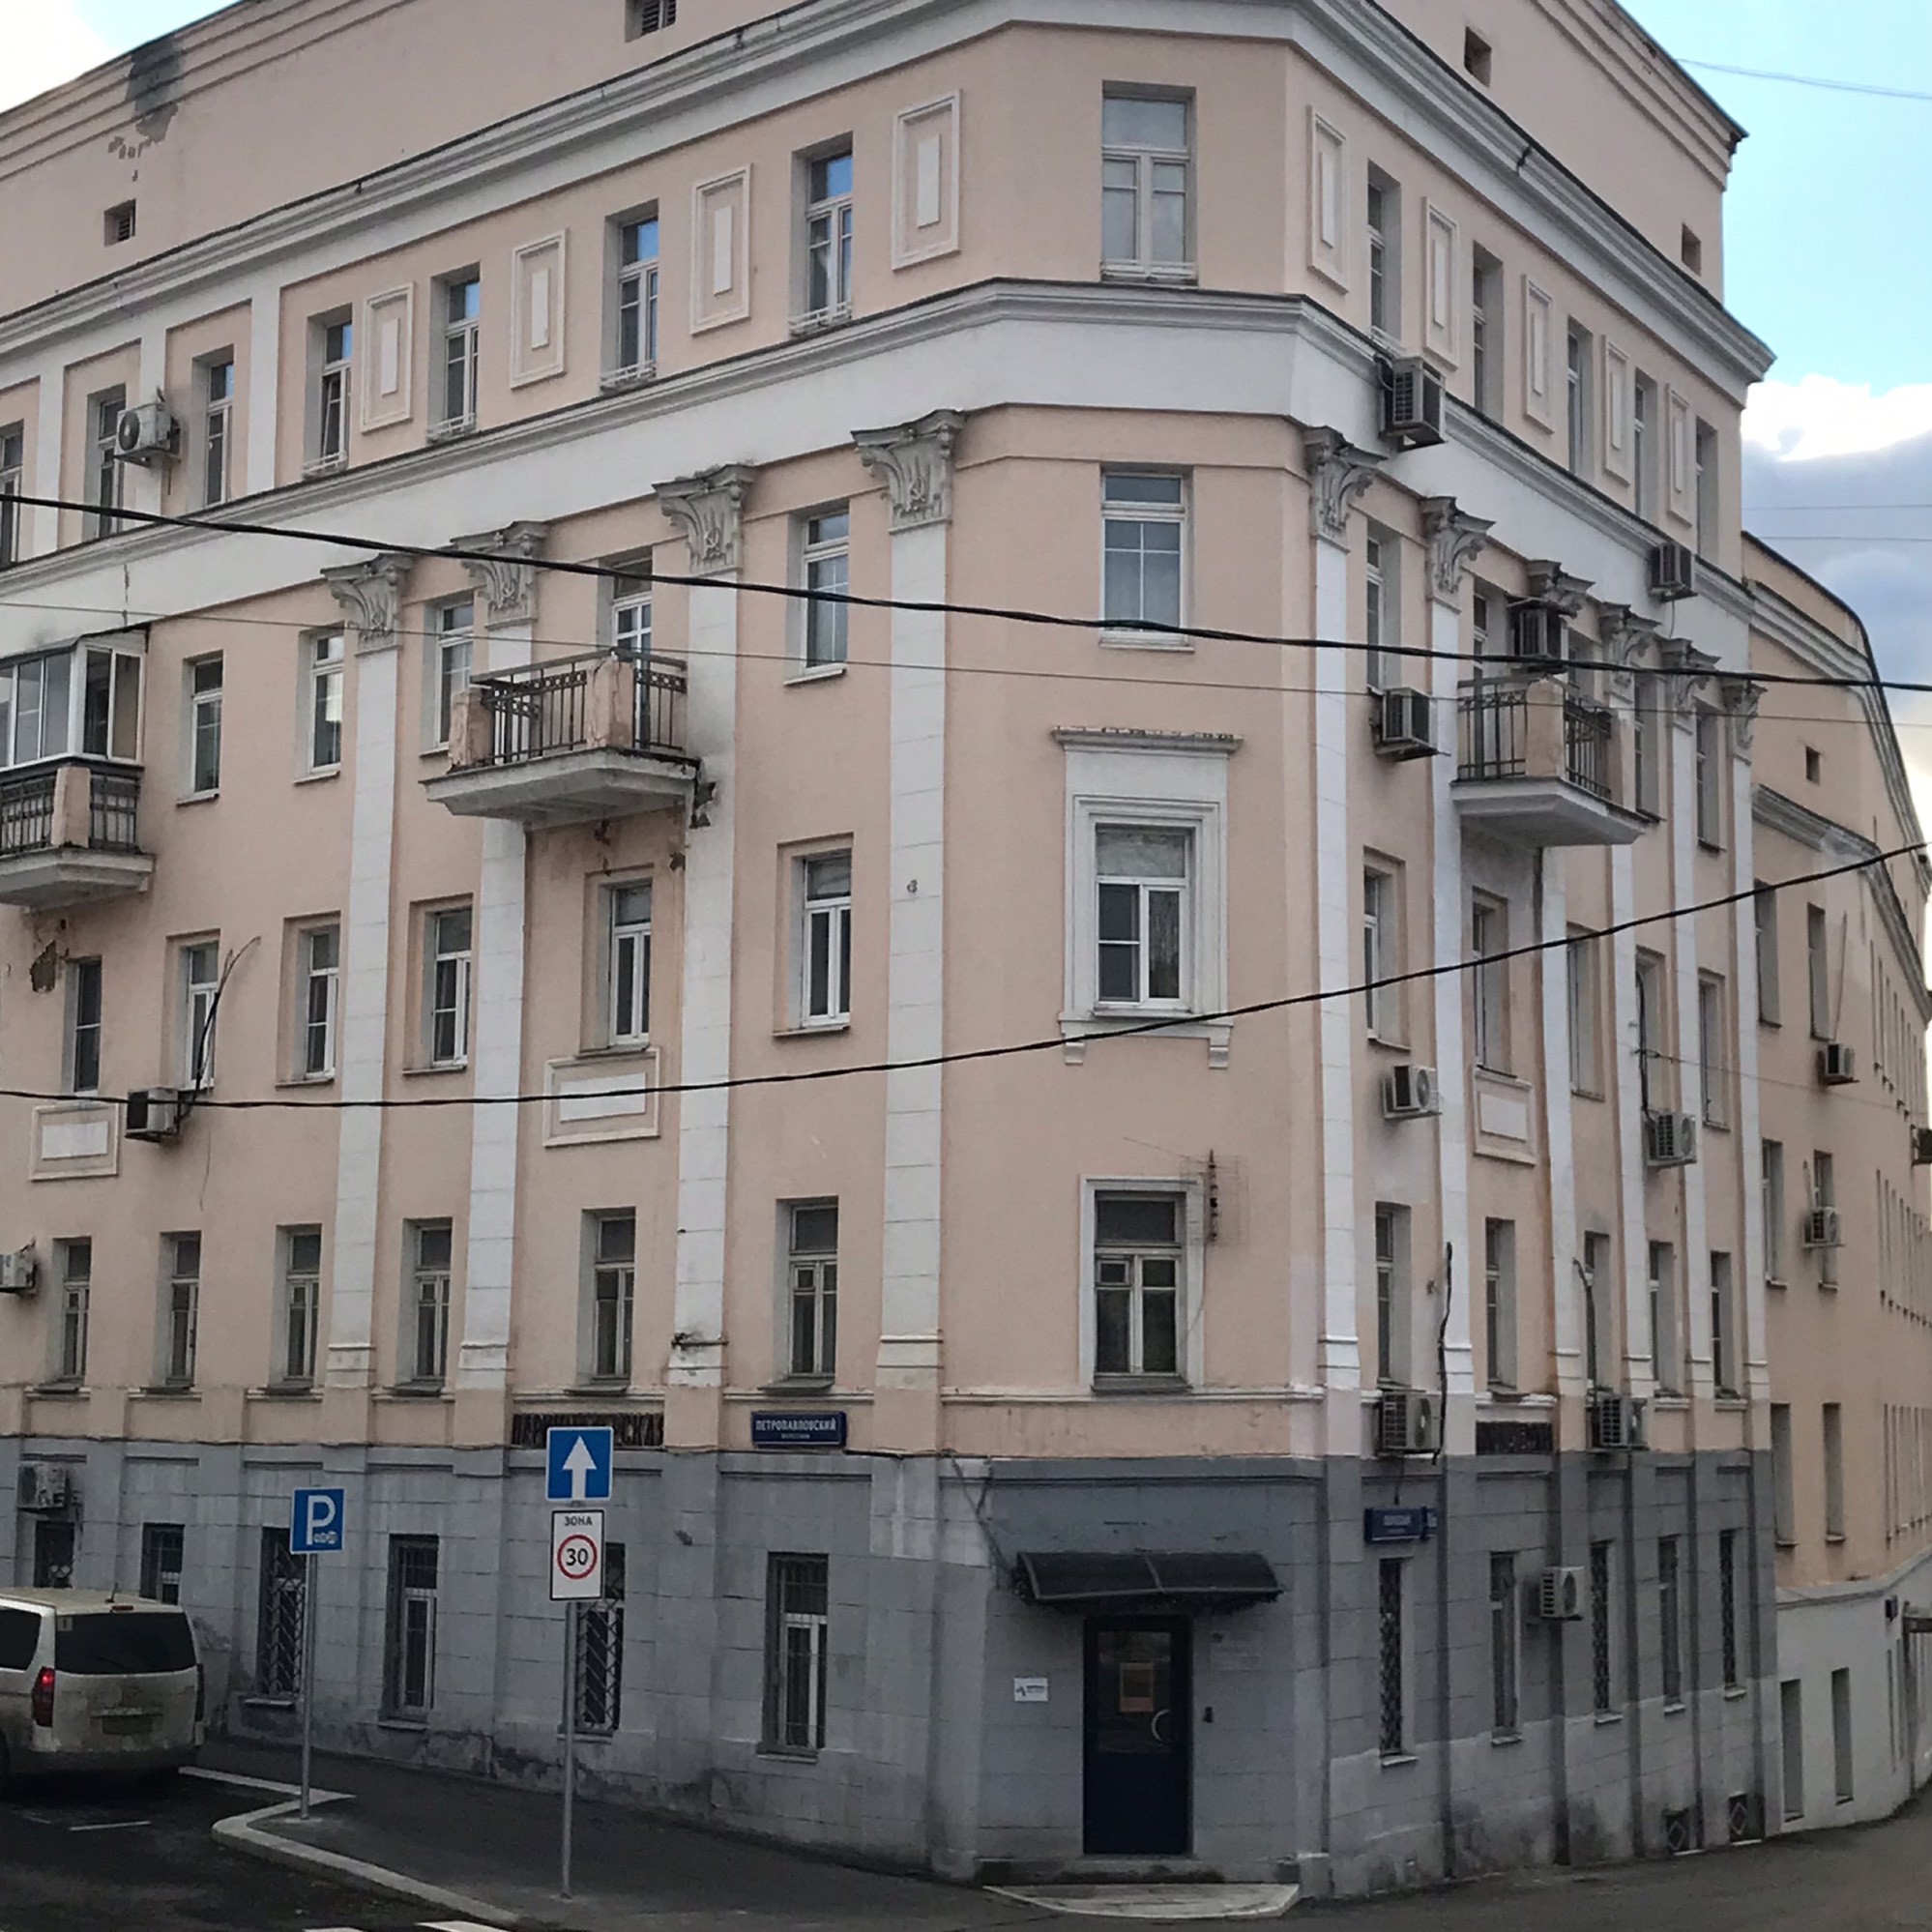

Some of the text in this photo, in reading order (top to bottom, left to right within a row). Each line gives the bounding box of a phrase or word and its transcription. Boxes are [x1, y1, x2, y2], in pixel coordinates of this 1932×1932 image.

[755, 1418, 836, 1431] ПЕТРОПАВЛОВСКИЙ
[306, 1495, 336, 1545] P
[564, 1515, 593, 1527] ЗОНА
[566, 1548, 589, 1566] 30
